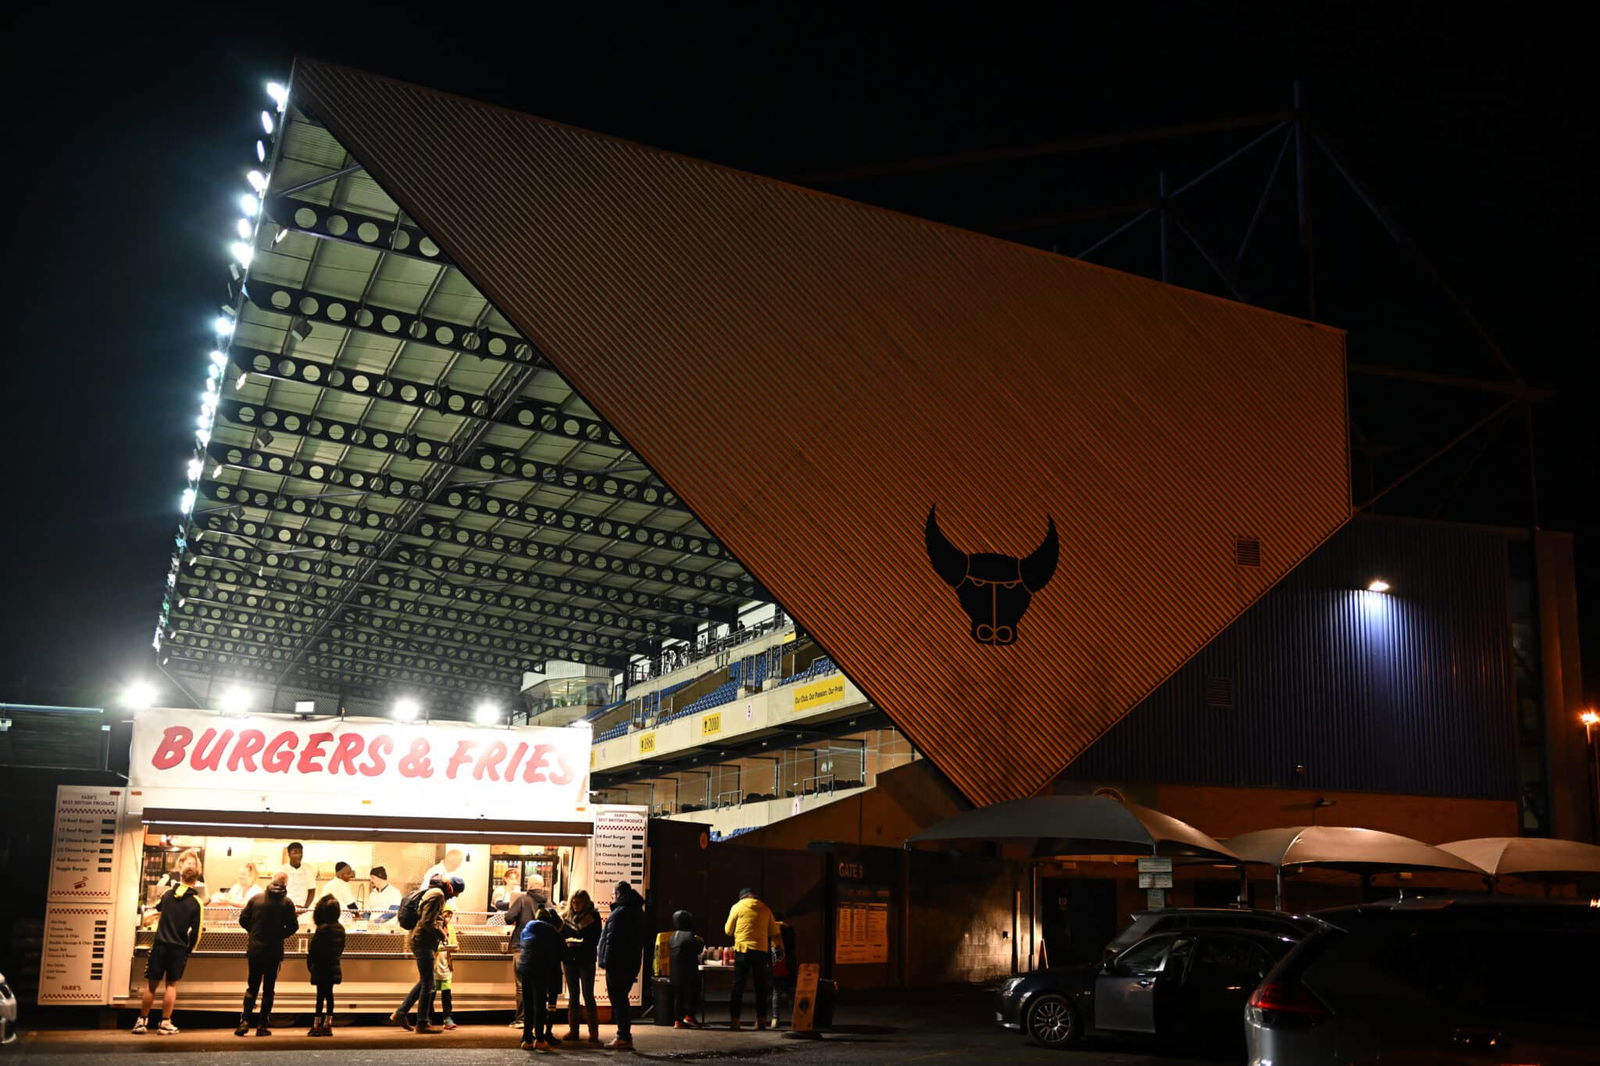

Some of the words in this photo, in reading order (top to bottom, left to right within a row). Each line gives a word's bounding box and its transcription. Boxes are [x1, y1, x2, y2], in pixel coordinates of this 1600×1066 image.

[151, 726, 394, 778] BURGERS
[398, 737, 434, 778] &
[446, 739, 575, 786] FRIES
[839, 862, 858, 878] GATE
